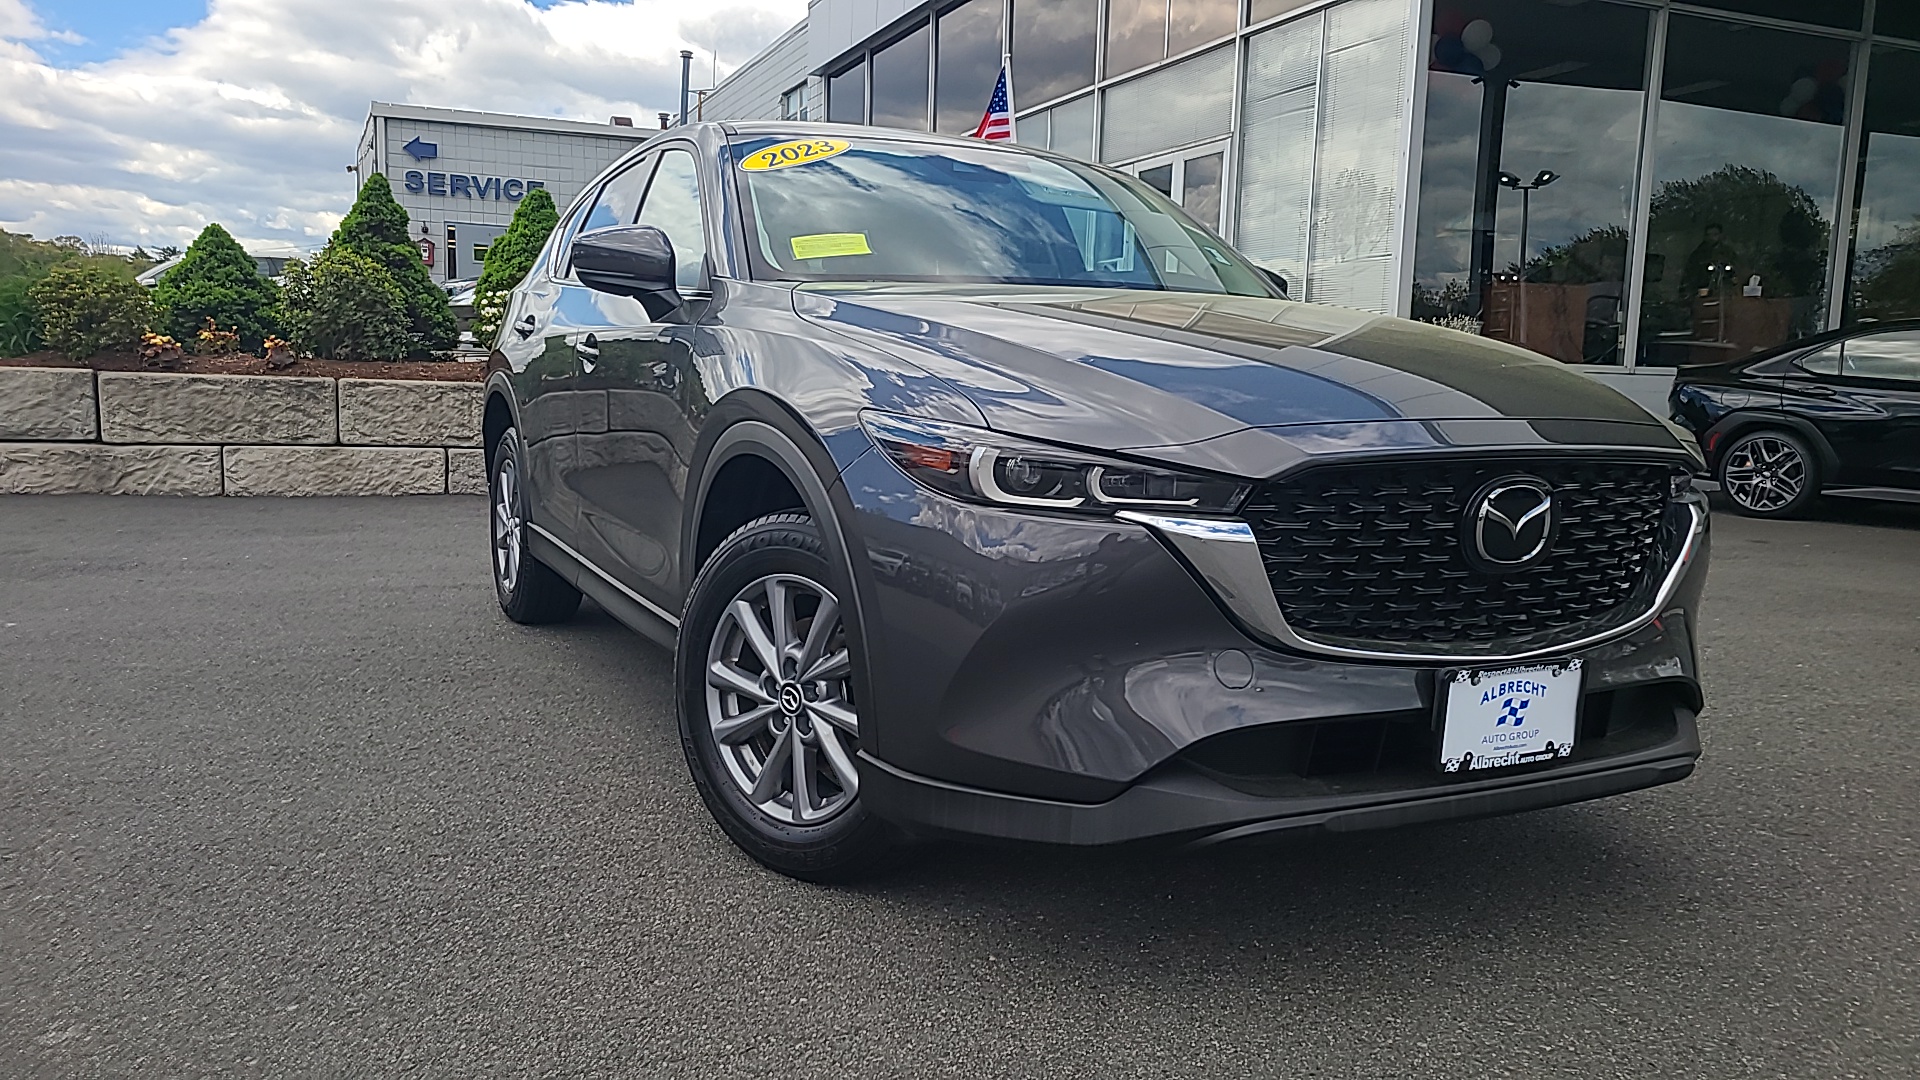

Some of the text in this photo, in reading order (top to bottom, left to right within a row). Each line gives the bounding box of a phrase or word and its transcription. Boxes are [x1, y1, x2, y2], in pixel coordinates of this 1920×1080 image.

[762, 140, 835, 168] 2023
[1480, 680, 1547, 705] ALBRECHT
[1481, 729, 1540, 745] AUTO GROUP
[1469, 753, 1520, 770] Albrecht
